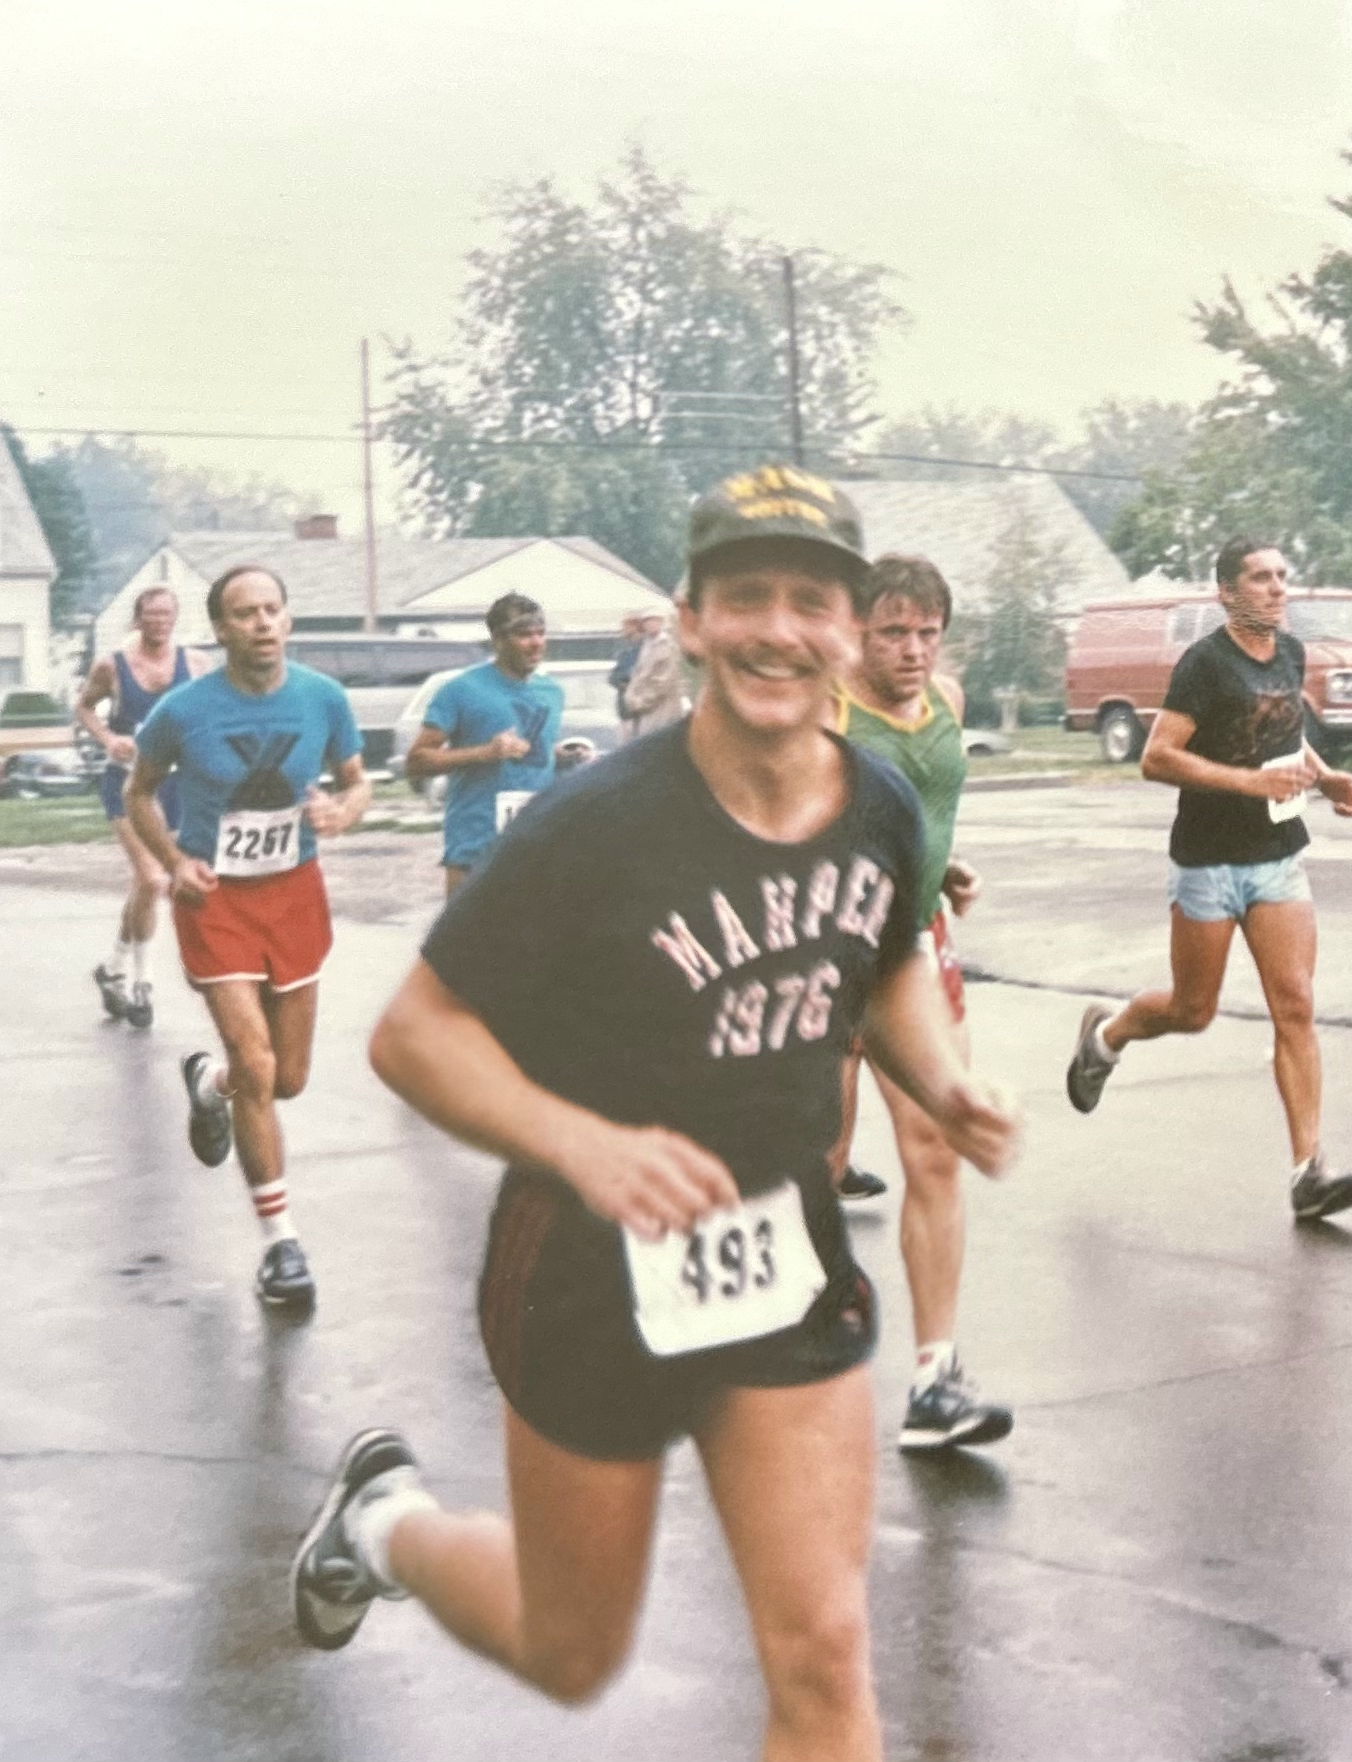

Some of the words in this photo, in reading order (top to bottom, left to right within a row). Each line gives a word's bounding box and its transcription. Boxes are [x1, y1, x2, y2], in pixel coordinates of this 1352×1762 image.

[225, 822, 294, 861] 2267
[707, 958, 842, 1058] 1976
[681, 1217, 775, 1303] 493
